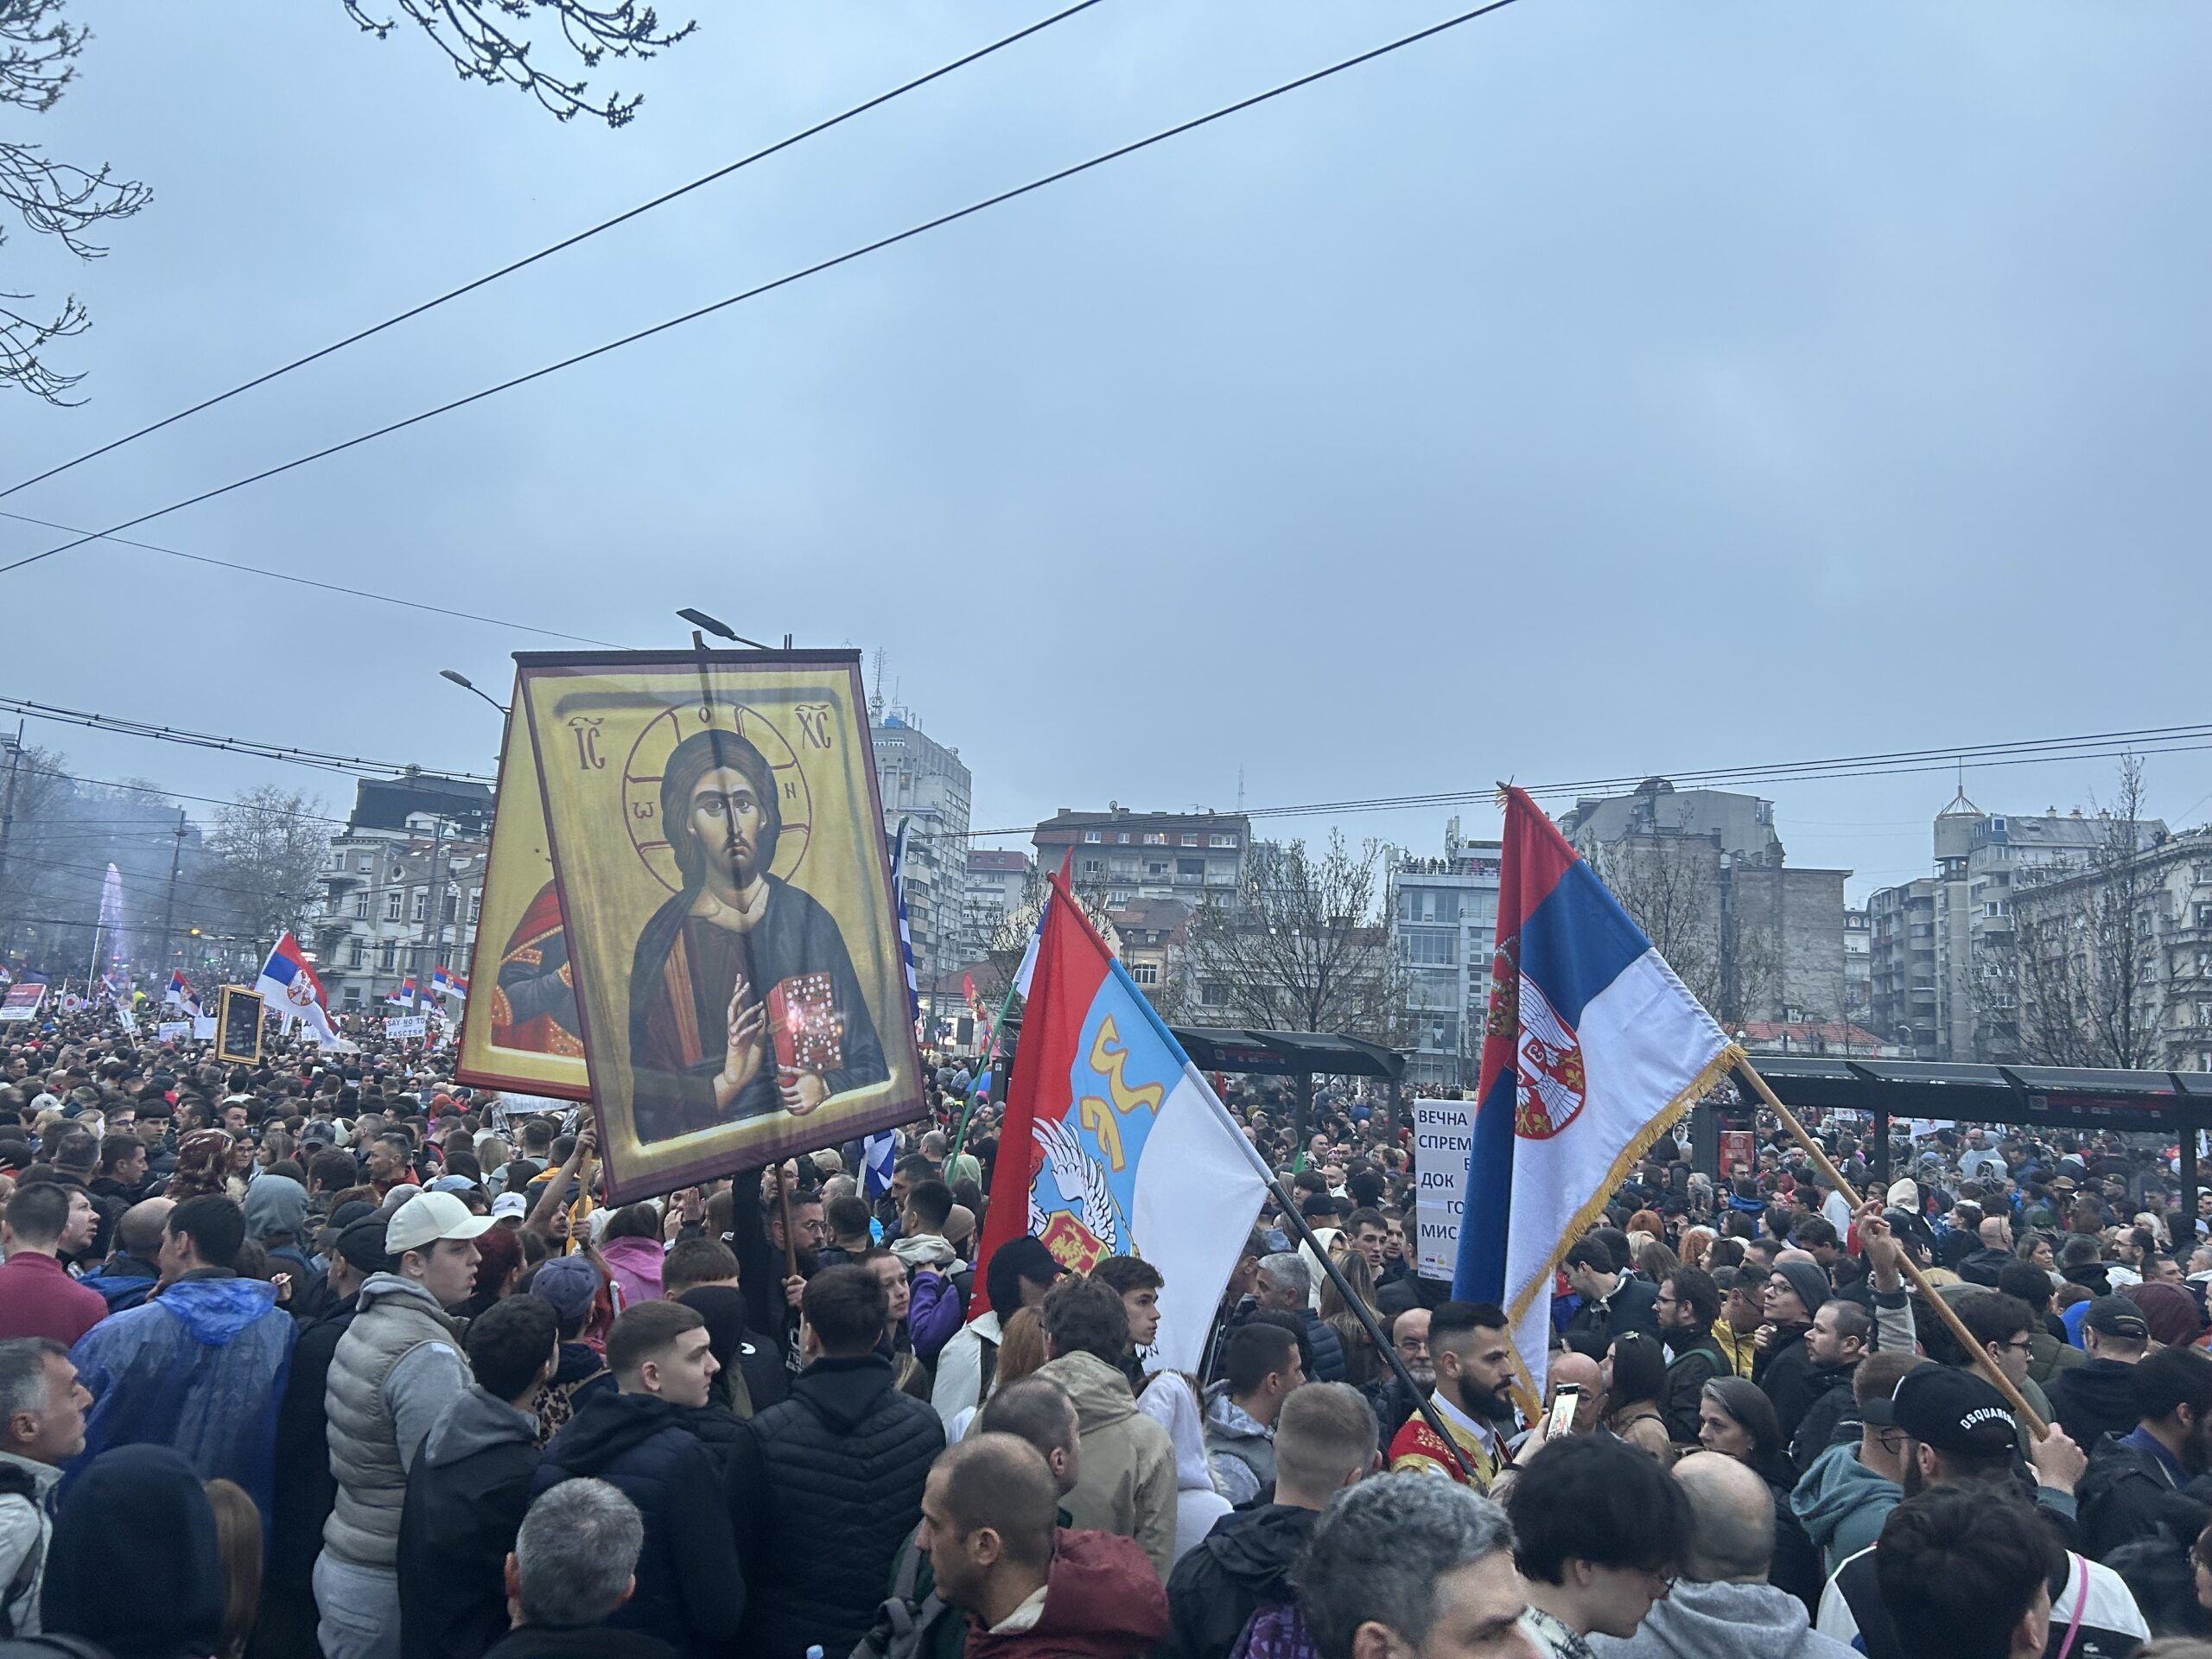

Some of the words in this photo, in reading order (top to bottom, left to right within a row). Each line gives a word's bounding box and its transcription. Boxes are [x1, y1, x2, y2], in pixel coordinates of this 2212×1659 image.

[1419, 1109, 1468, 1127] ВЕЧНА
[1421, 1172, 1454, 1190] ДОК
[1421, 1224, 1460, 1240] МИС
